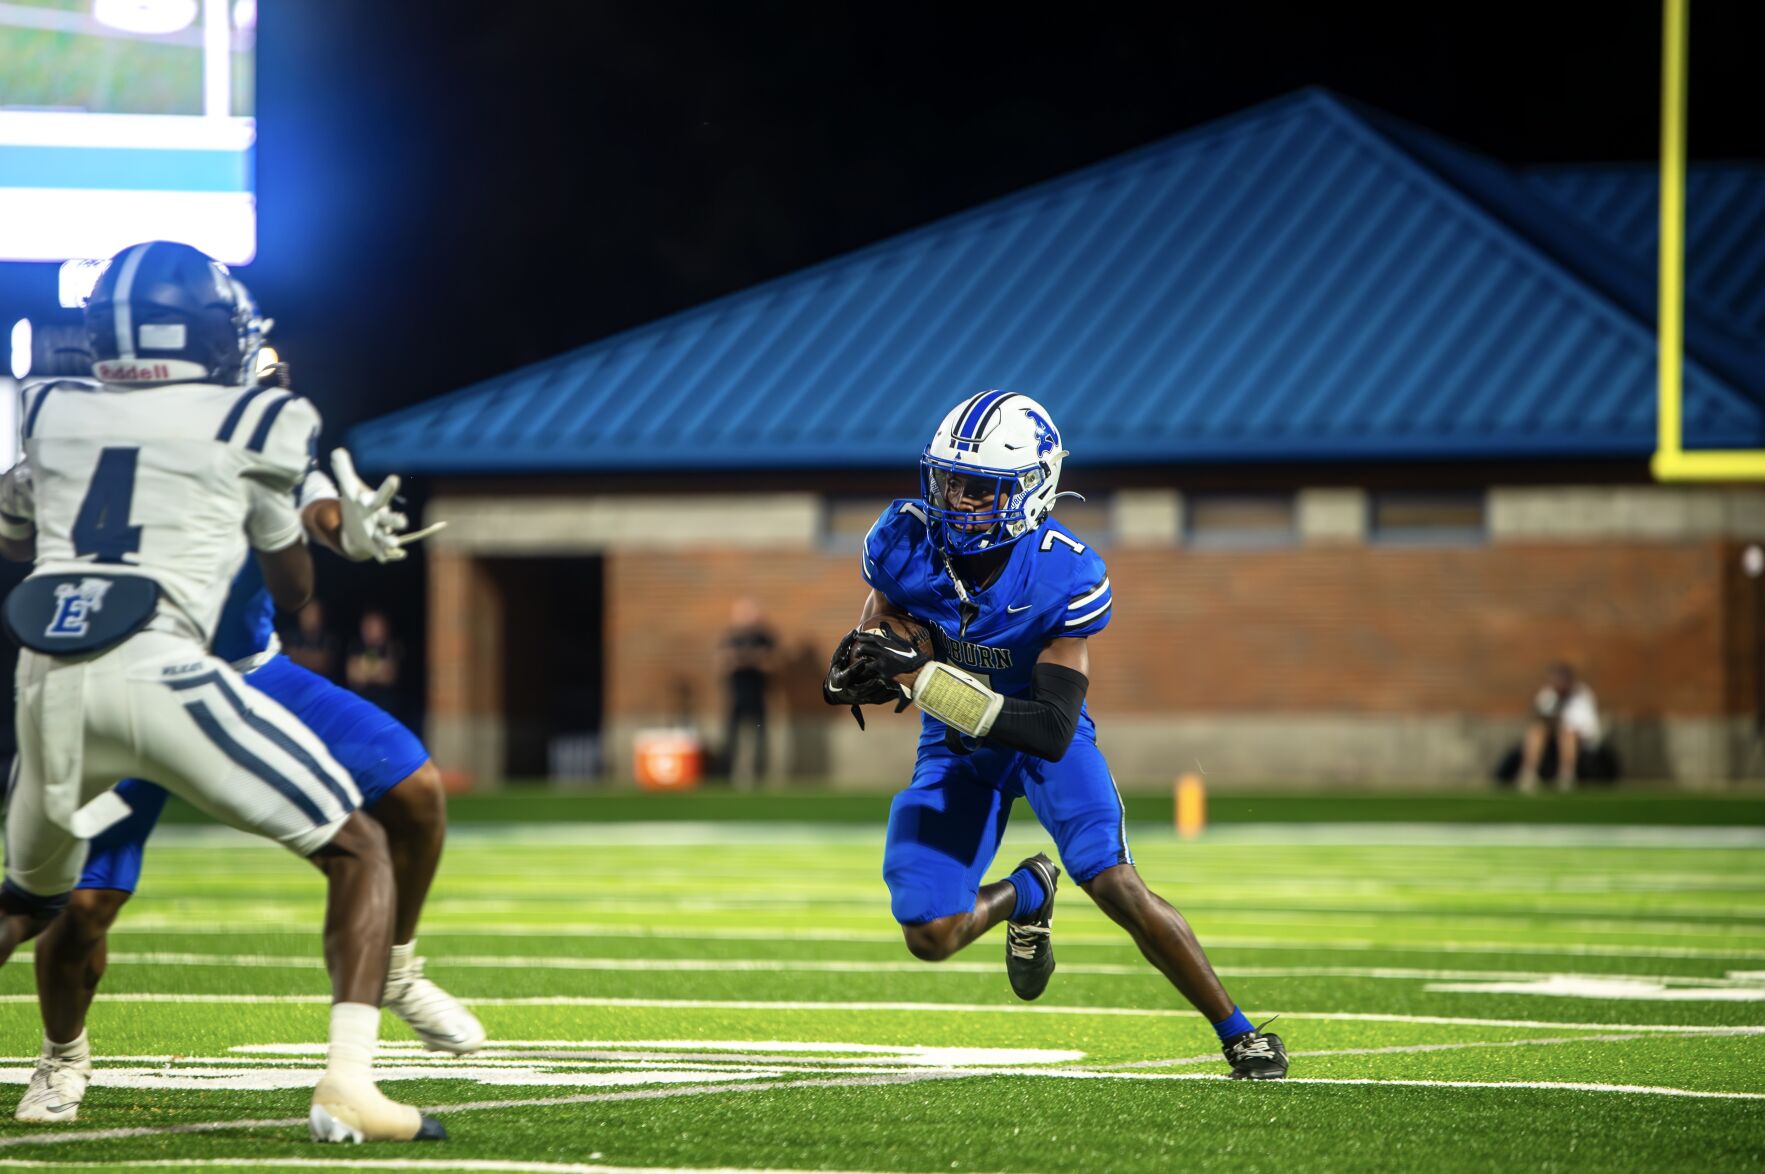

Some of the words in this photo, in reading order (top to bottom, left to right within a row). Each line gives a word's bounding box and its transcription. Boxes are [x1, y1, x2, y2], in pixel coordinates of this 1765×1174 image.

[99, 363, 169, 380] Riddell
[71, 447, 143, 566] 4
[1039, 528, 1086, 556] 7
